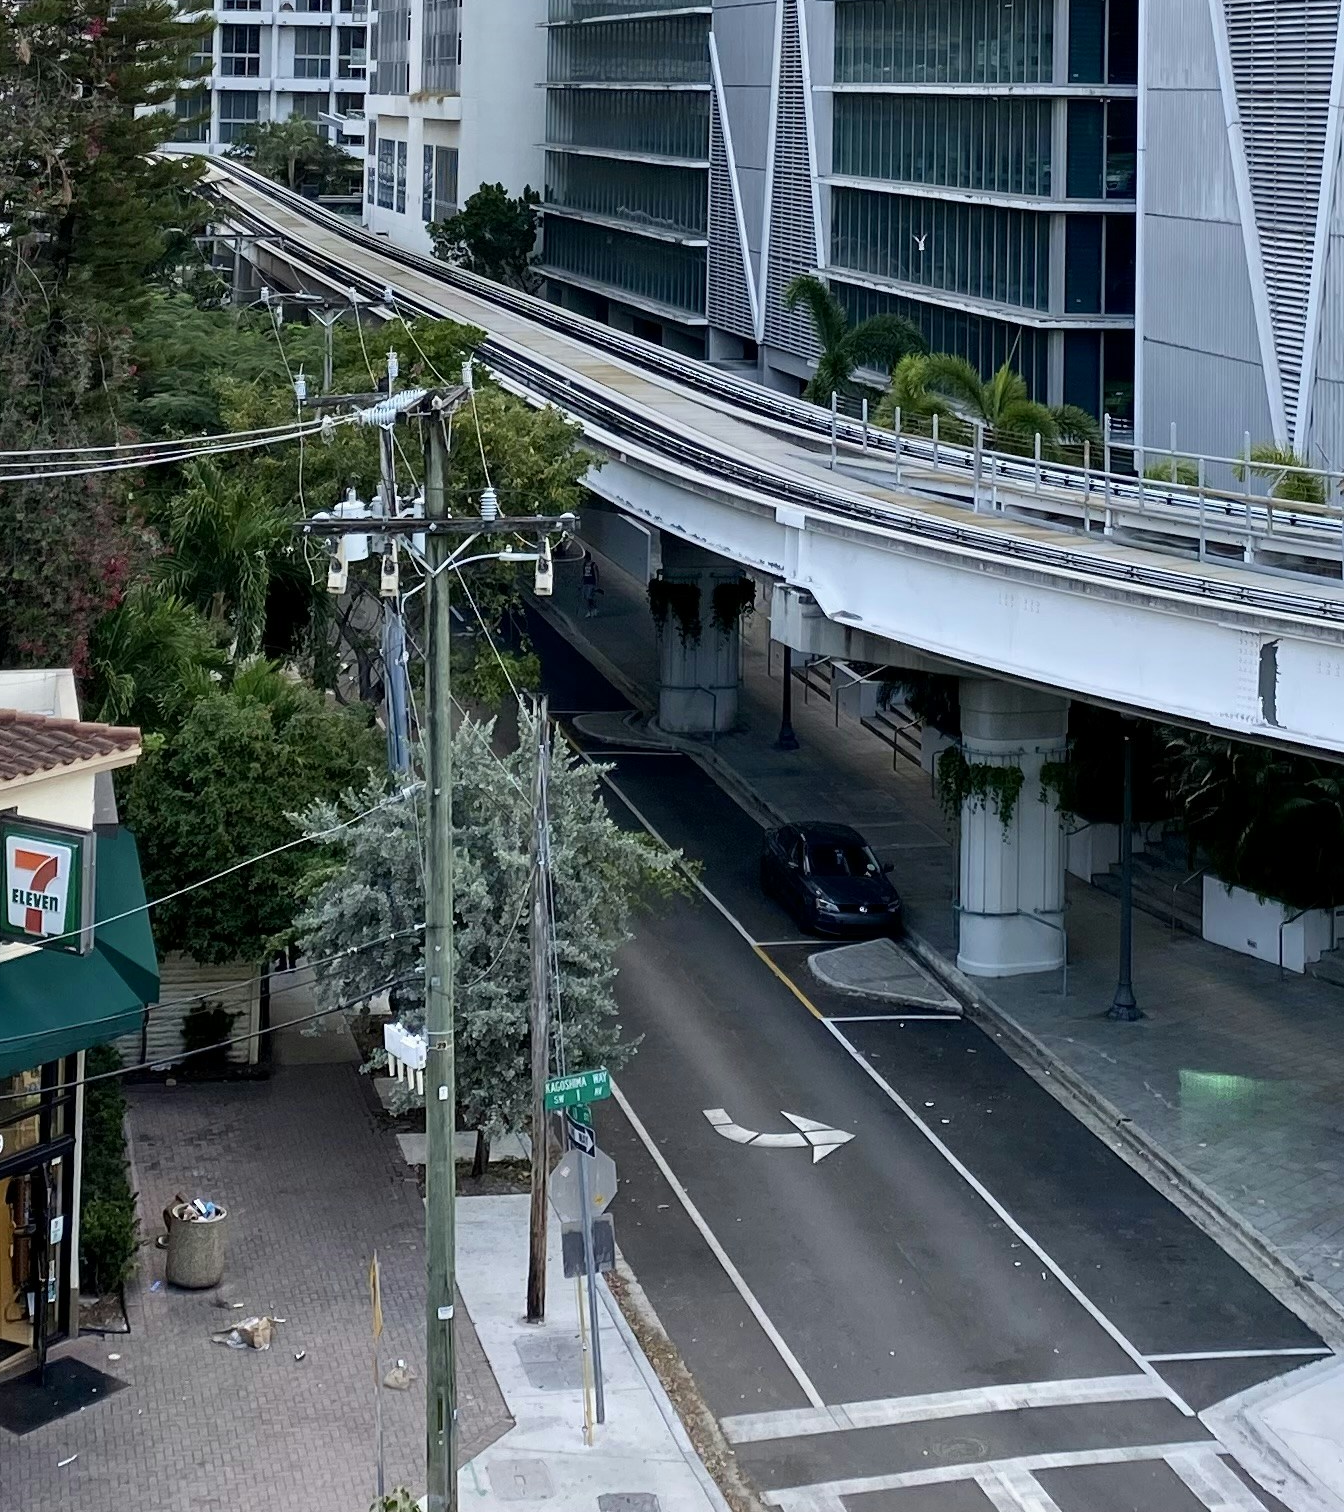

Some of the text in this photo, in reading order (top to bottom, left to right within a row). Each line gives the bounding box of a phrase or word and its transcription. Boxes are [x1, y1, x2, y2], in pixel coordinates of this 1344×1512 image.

[14, 849, 58, 933] 7
[545, 1071, 607, 1094] KAGOSHIMA WAY
[553, 1094, 565, 1105] SW
